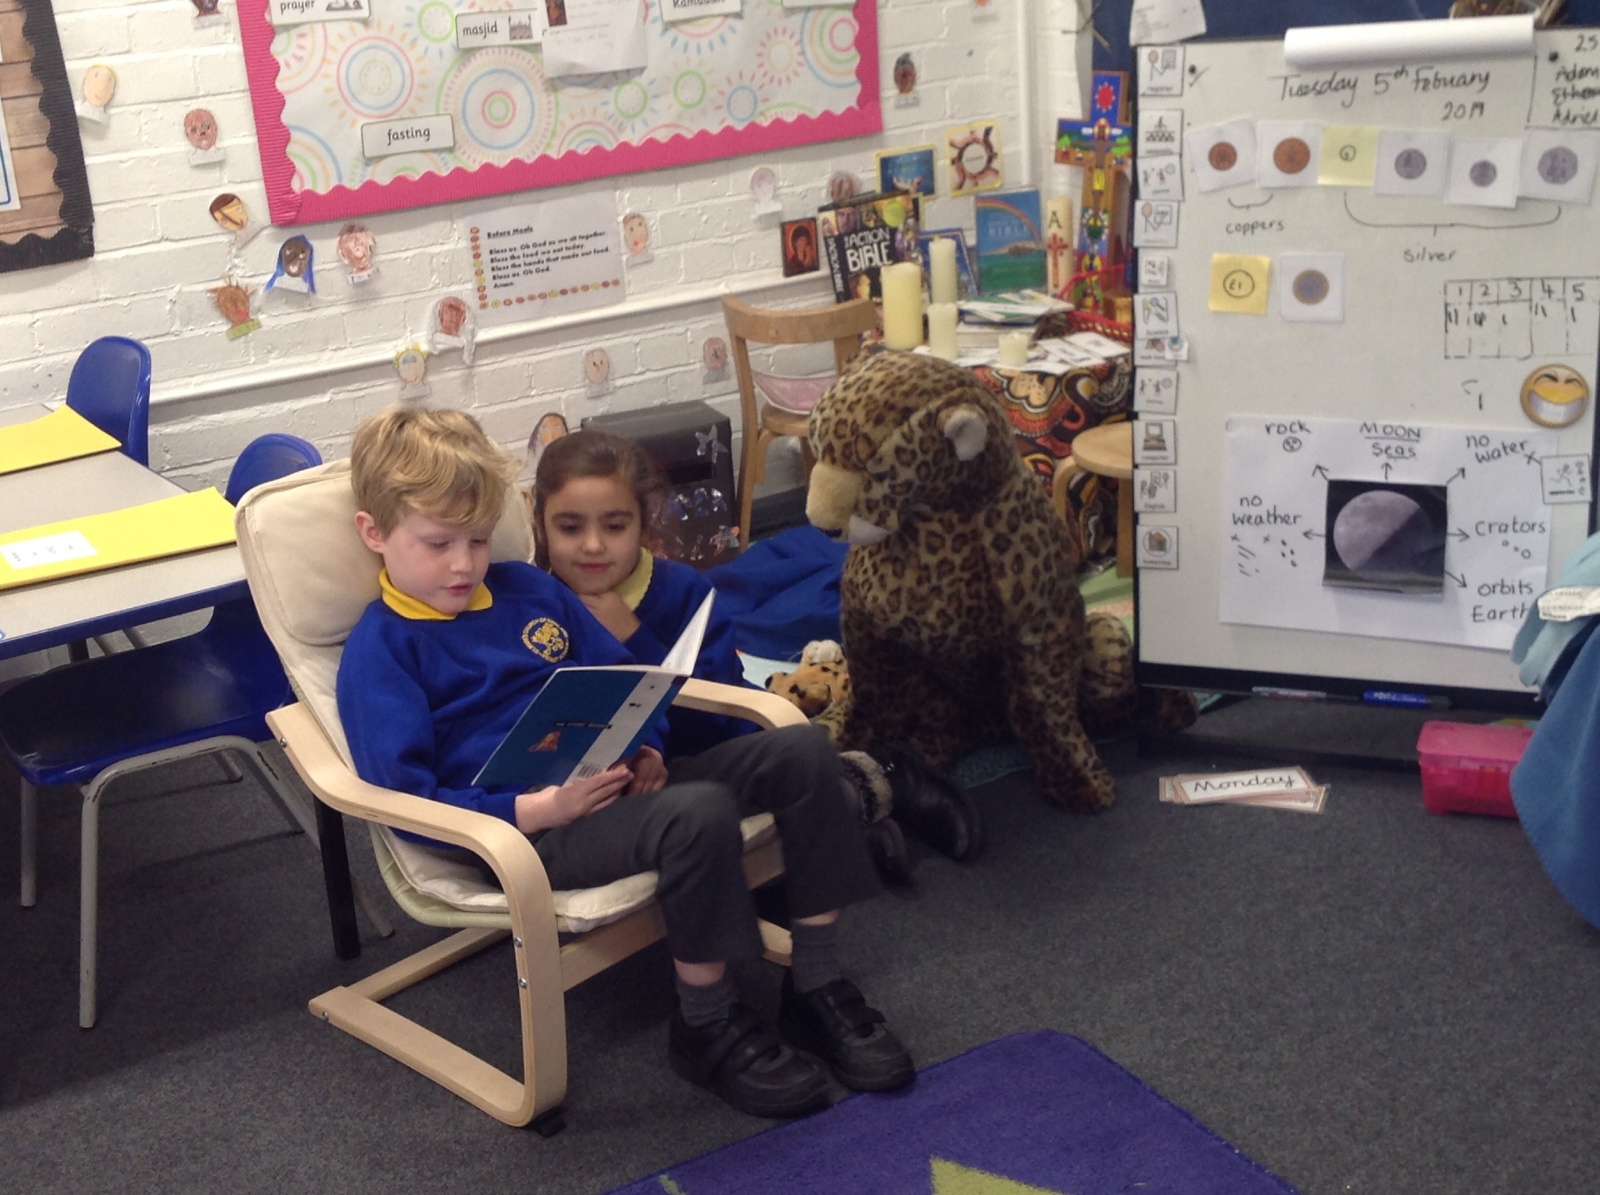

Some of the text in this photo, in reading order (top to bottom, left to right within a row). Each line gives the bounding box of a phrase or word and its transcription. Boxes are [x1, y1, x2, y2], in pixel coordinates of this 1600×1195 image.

[280, 0, 315, 14] prayer
[462, 21, 498, 39] masjid
[1268, 70, 1358, 109] Tuesday
[387, 128, 430, 146] fasting
[1225, 220, 1285, 237] coppers
[532, 240, 547, 249] God
[846, 241, 893, 272] BIBLE
[1403, 247, 1455, 263] silver
[1478, 283, 1490, 297] 2
[1508, 279, 1523, 298] 3
[1541, 278, 1556, 299] 4
[1572, 282, 1586, 302] 5
[1265, 421, 1311, 435] rock
[1359, 422, 1422, 440] MOON
[1465, 435, 1491, 449] no
[1475, 440, 1529, 464] water
[1239, 496, 1263, 507] no
[1232, 511, 1303, 527] weather
[1477, 578, 1533, 597] orbits
[1192, 774, 1296, 794] Monday
